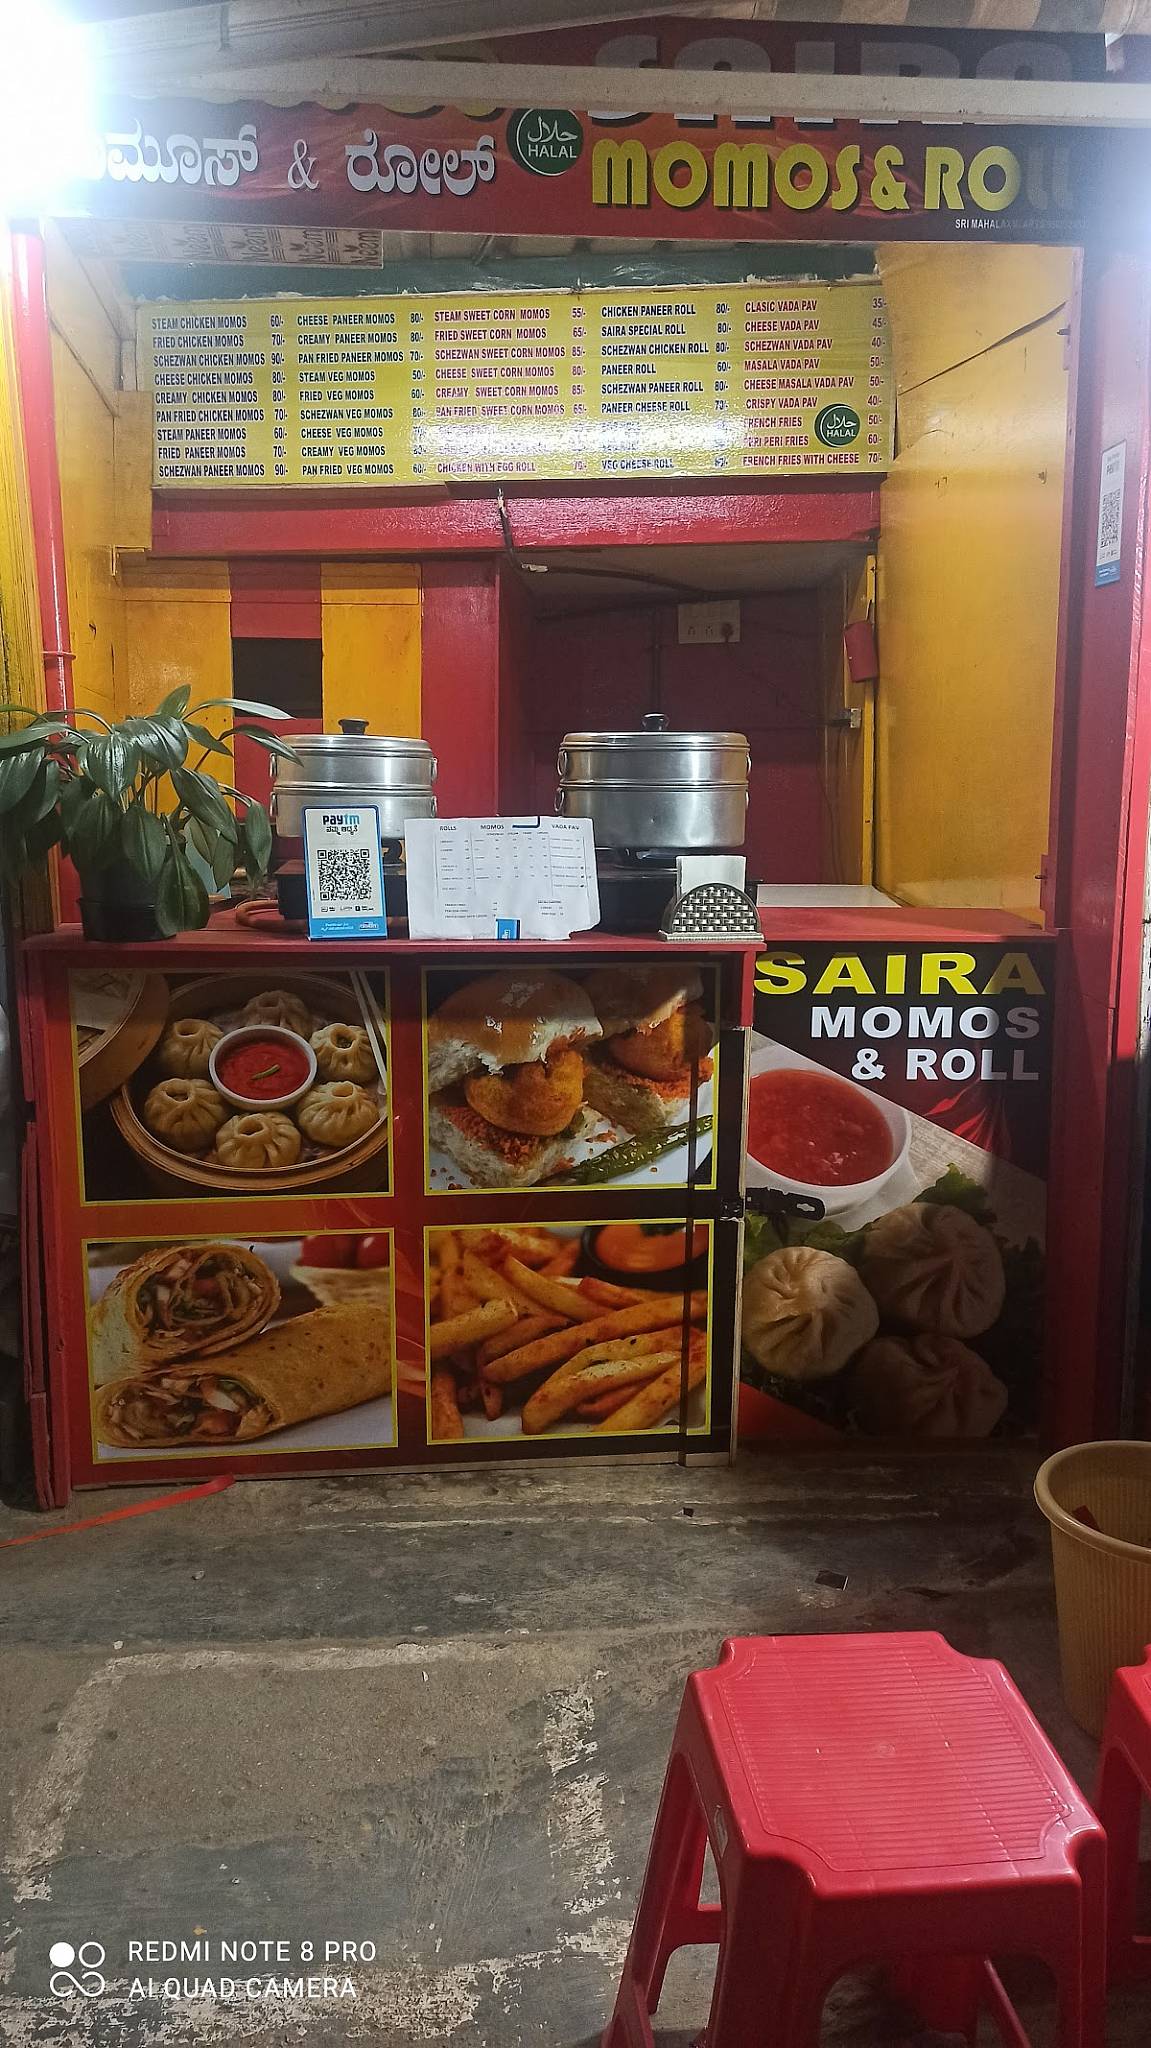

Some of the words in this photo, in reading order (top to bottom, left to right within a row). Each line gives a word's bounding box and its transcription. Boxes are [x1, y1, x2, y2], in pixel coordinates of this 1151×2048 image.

[527, 116, 578, 143] حلال
[528, 144, 577, 158] HALAL
[287, 140, 319, 190] &
[592, 139, 860, 211] MOMOS
[870, 144, 910, 211] &
[955, 218, 969, 229] SRI
[242, 227, 270, 262] Neem
[351, 230, 380, 266] Neem
[602, 306, 638, 317] CHICKEN
[641, 305, 672, 317] PANEER
[675, 304, 696, 315] ROLL
[745, 302, 775, 313] CLASIC
[778, 301, 800, 312] VADA
[802, 300, 817, 311] PAV
[297, 314, 328, 326] CHEESE
[333, 314, 362, 325] PANEER
[365, 314, 395, 324] MOMOS
[434, 310, 461, 321] STEAM
[464, 310, 491, 320] SWEET
[494, 310, 515, 320] CORN
[520, 309, 550, 319] MOMOS
[152, 317, 178, 329] STEAM
[181, 316, 215, 329] CHICKEN
[218, 316, 247, 328] MOMOS
[745, 321, 778, 332] CHEESE
[780, 320, 802, 331] VADA
[804, 319, 819, 330] PAV
[435, 330, 458, 340] FRIED
[460, 329, 487, 340] SWEET
[490, 329, 512, 339] CORN
[516, 328, 546, 338] MOMOS
[602, 325, 626, 337] SAIRA
[628, 325, 662, 336] SPECIAL
[665, 324, 685, 335] ROLL
[153, 337, 176, 348] FRIED
[178, 336, 213, 347] CHICKEN
[215, 335, 243, 346] MOMOS
[298, 333, 330, 345] CREAMY
[335, 333, 366, 344] PANEER
[368, 332, 397, 343] MOMOS
[745, 341, 790, 351] SCHEZWAN
[792, 340, 814, 350] VADA
[816, 339, 832, 349] PAV
[435, 349, 479, 360] SCHEZWAN
[482, 348, 508, 359] SWEET
[511, 348, 532, 358] CORN
[535, 347, 565, 357] MOMOS
[602, 345, 646, 356] SCHEZWAN
[649, 344, 686, 355] CHICKEN
[688, 343, 709, 353] ROLL
[154, 355, 196, 367] SCHEZWAN
[199, 354, 234, 366] CHICKEN
[237, 353, 265, 365] MOMOS
[298, 353, 314, 363] PAN
[316, 352, 339, 363] FRIED
[342, 352, 372, 362] PANEER
[375, 351, 403, 362] MOMOS
[602, 365, 633, 375] PANEER
[636, 364, 656, 374] ROLL
[744, 360, 778, 371] MASALA
[780, 360, 801, 370] VADA
[804, 359, 819, 369] PAV
[155, 373, 185, 385] CHEESE
[187, 373, 222, 384] CHICKEN
[224, 372, 252, 384] MOMOS
[299, 371, 326, 382] STEAM
[328, 371, 343, 381] VEG
[346, 371, 374, 381] MOMOS
[436, 368, 466, 379] CHEESE
[472, 368, 498, 378] SWEET
[500, 367, 522, 377] CORN
[525, 366, 554, 377] MOMOS
[602, 383, 646, 394] SCHEZWAN
[649, 382, 681, 393] PANEER
[683, 381, 703, 392] ROLL
[744, 379, 776, 390] CHEESE
[778, 378, 812, 389] MASALA
[814, 377, 837, 388] VADA
[839, 377, 854, 387] PAV
[155, 392, 187, 404] CREAMY
[192, 392, 226, 403] CHICKEN
[228, 391, 257, 402] MOMOS
[300, 390, 322, 401] FRIED
[327, 390, 342, 400] VEG
[345, 389, 374, 400] MOMOS
[436, 388, 468, 398] CREAMY
[476, 387, 502, 397] SWEET
[504, 386, 526, 396] CORN
[529, 386, 558, 396] MOMOS
[602, 403, 633, 413] PANEER
[746, 398, 776, 409] CRISPY
[778, 398, 800, 408] VADA
[802, 397, 817, 407] PAV
[156, 410, 171, 422] PAN
[174, 410, 196, 421] FRIED
[198, 410, 233, 421] CHICKEN
[235, 409, 264, 420] MOMOS
[301, 409, 343, 419] SCHEZWAN
[346, 409, 362, 419] VEG
[364, 408, 393, 418] MOMOS
[779, 417, 802, 427] FRIES
[826, 414, 857, 429] حلال
[158, 429, 183, 440] STEAM
[185, 429, 215, 440] PANEER
[217, 428, 246, 439] MOMOS
[301, 428, 331, 438] CHEESE
[336, 428, 352, 437] VEG
[354, 427, 383, 437] MOMOS
[826, 429, 855, 438] HALAL
[785, 435, 808, 446] FRIES
[159, 447, 180, 459] FRIED
[185, 447, 215, 458] PANEER
[217, 447, 245, 458] MOMOS
[302, 447, 334, 457] CREAMY
[339, 446, 354, 456] VEG
[356, 446, 385, 456] MOMOS
[743, 455, 776, 466] FRENCH
[778, 454, 801, 465] FRIES
[803, 454, 824, 464] WITH
[827, 453, 859, 464] CHEESE
[159, 466, 201, 477] SCHEZWAN
[204, 465, 234, 477] PANEER
[236, 465, 264, 476] MOMOS
[303, 465, 317, 475] PAN
[320, 465, 342, 474] FRIED
[347, 465, 362, 474] VEG
[365, 464, 393, 474] MOMOS
[753, 952, 1046, 995] SAIRA
[811, 1006, 1040, 1039] MOMOS
[851, 1048, 885, 1080] &
[906, 1049, 1039, 1080] ROLL
